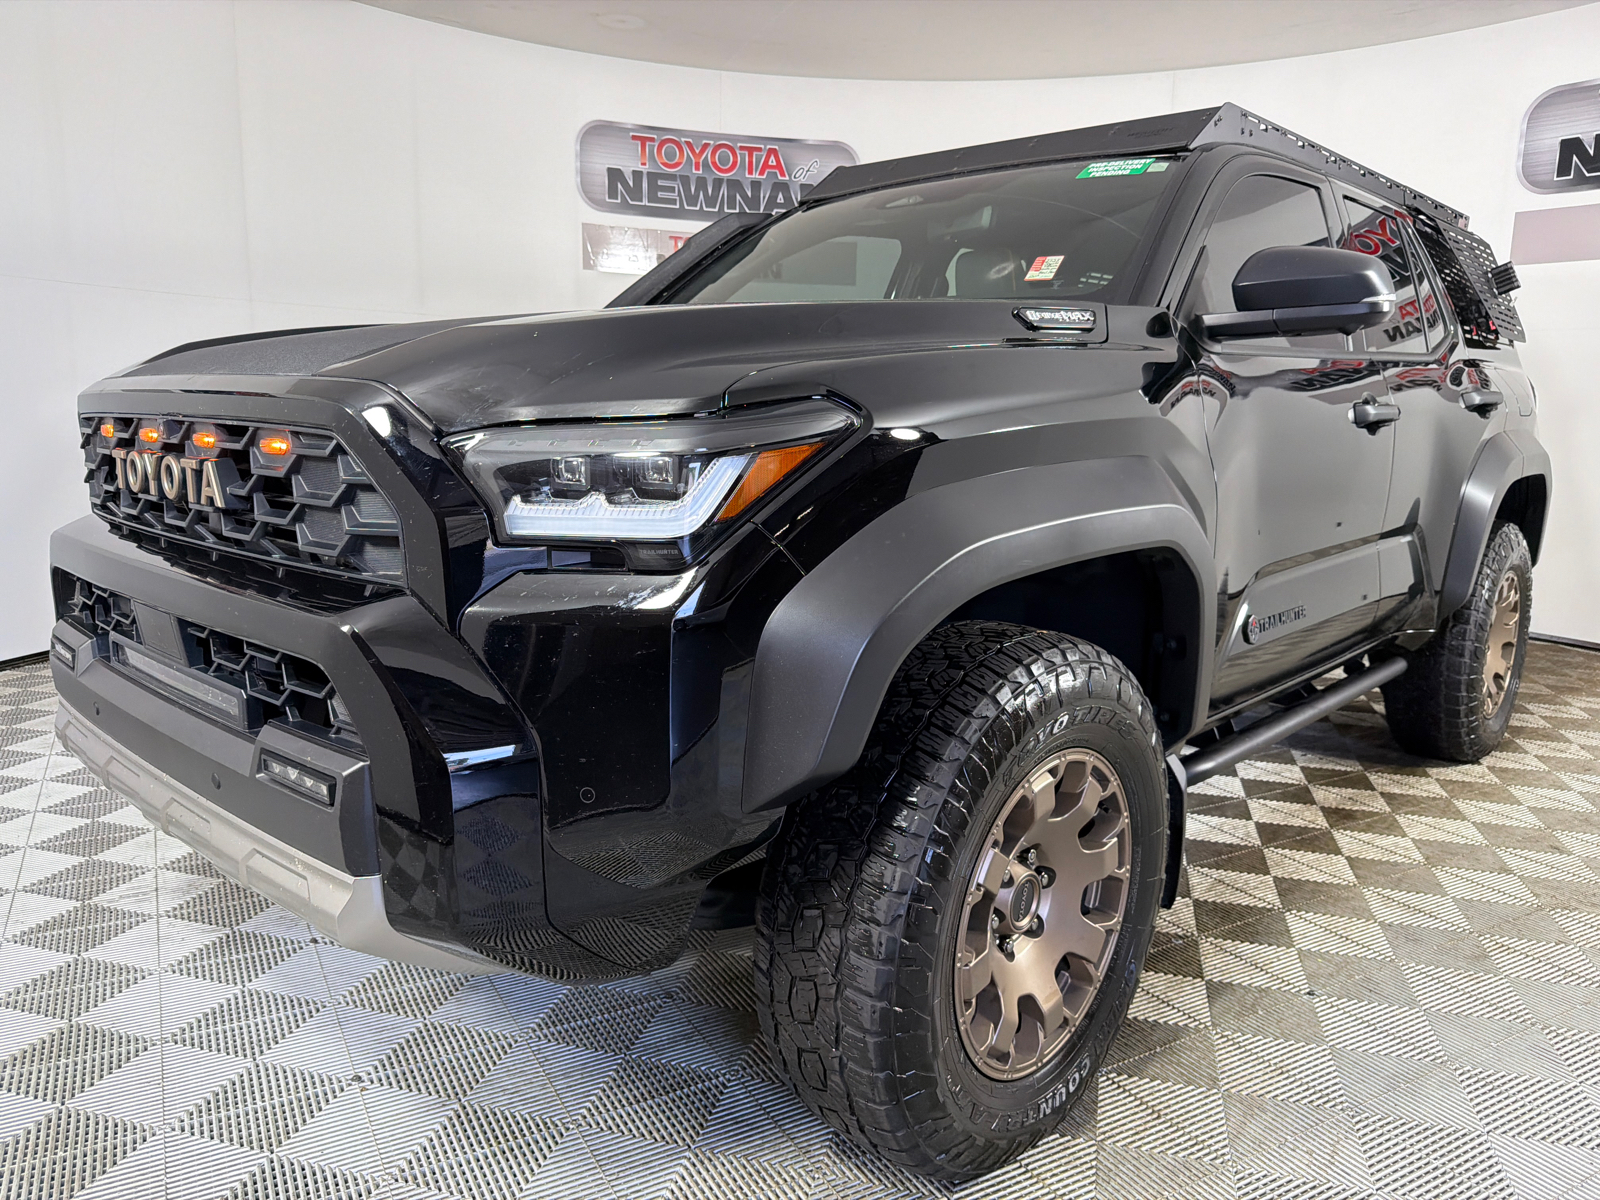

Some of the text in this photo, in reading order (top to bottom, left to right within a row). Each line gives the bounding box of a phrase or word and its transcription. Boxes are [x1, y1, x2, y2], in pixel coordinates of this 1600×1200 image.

[630, 133, 819, 182] TOYOTA of
[1087, 164, 1143, 173] INSPECTION
[1089, 159, 1154, 168] PRE-DELIVERY
[1089, 169, 1131, 178] PENDING
[606, 166, 815, 214] NEWNA
[111, 448, 226, 508] TOYOTA
[1018, 881, 1030, 922] TOYOTA
